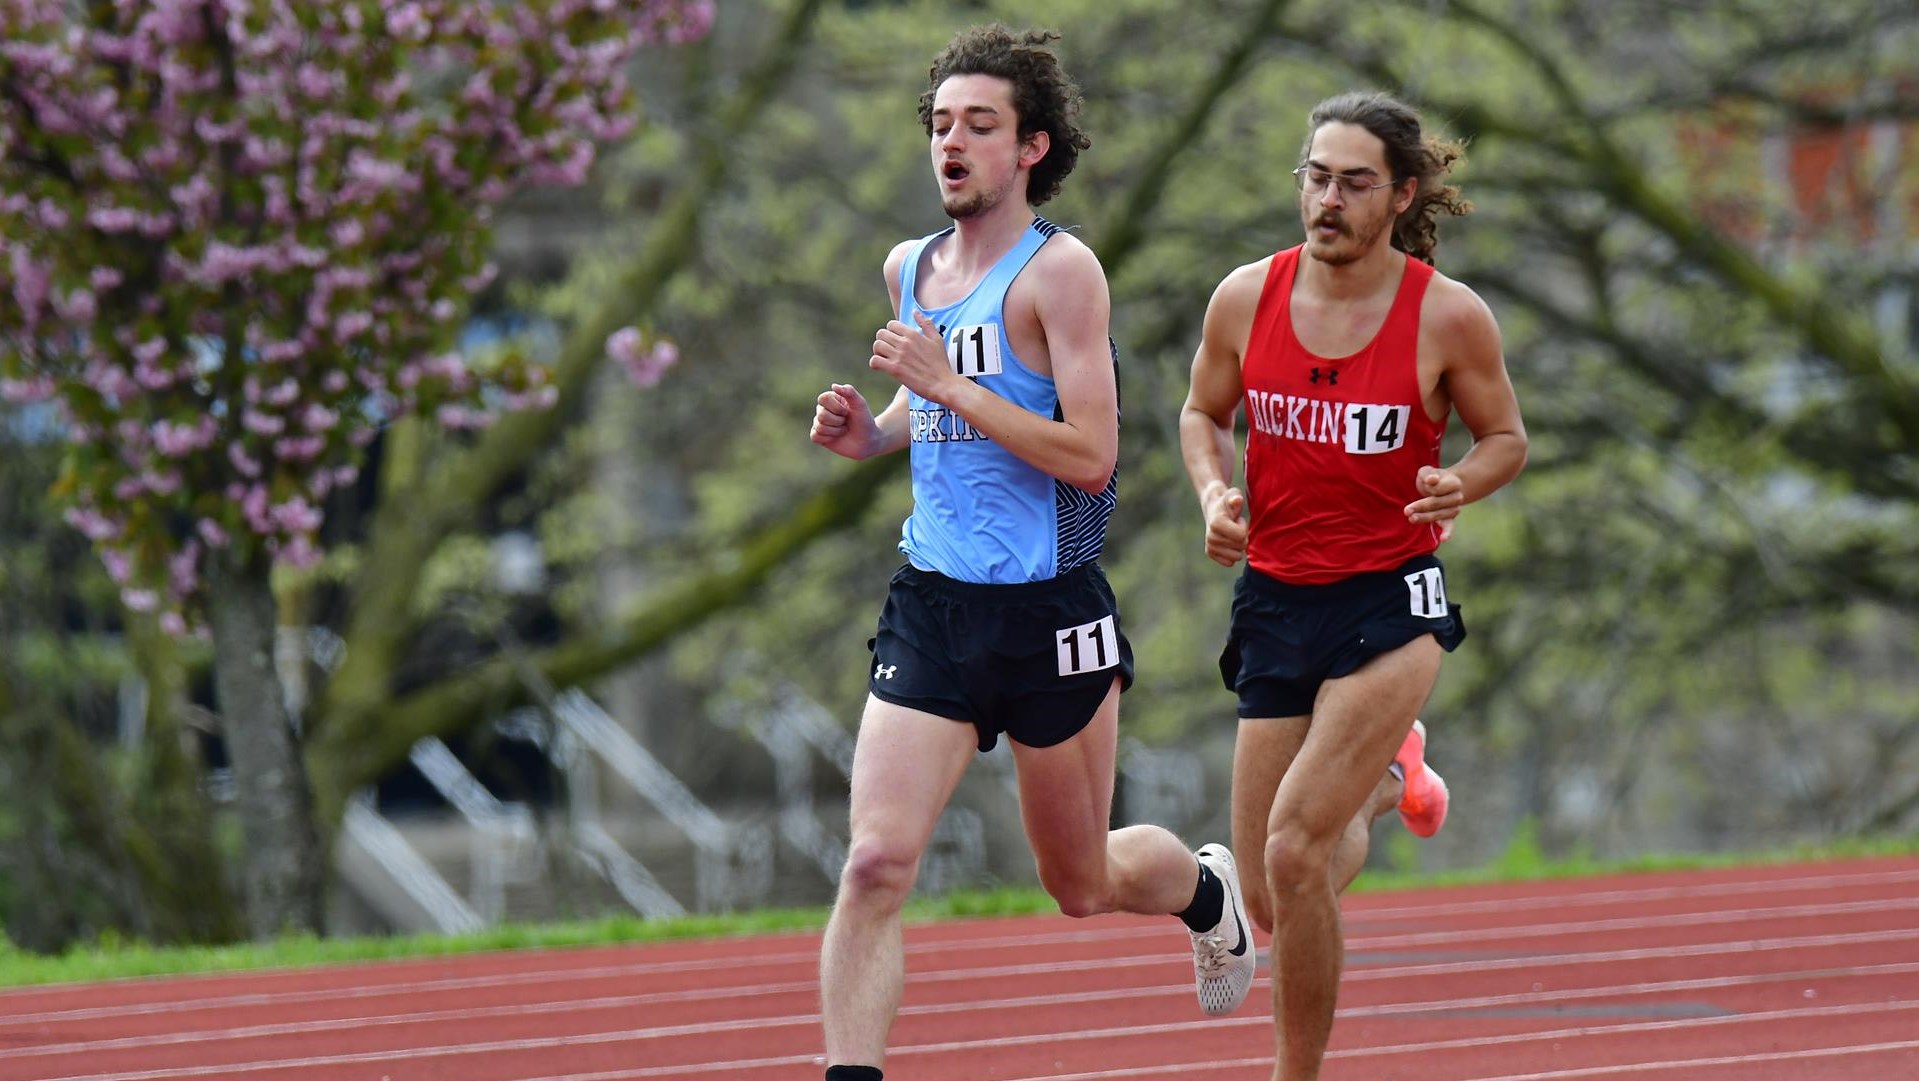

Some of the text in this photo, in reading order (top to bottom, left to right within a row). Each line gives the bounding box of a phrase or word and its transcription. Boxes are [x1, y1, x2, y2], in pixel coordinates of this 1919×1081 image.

[953, 326, 985, 374] 11
[1247, 389, 1348, 444] DICKIN
[1351, 407, 1399, 450] 14
[1412, 573, 1443, 615] 14
[1062, 622, 1106, 672] 11
